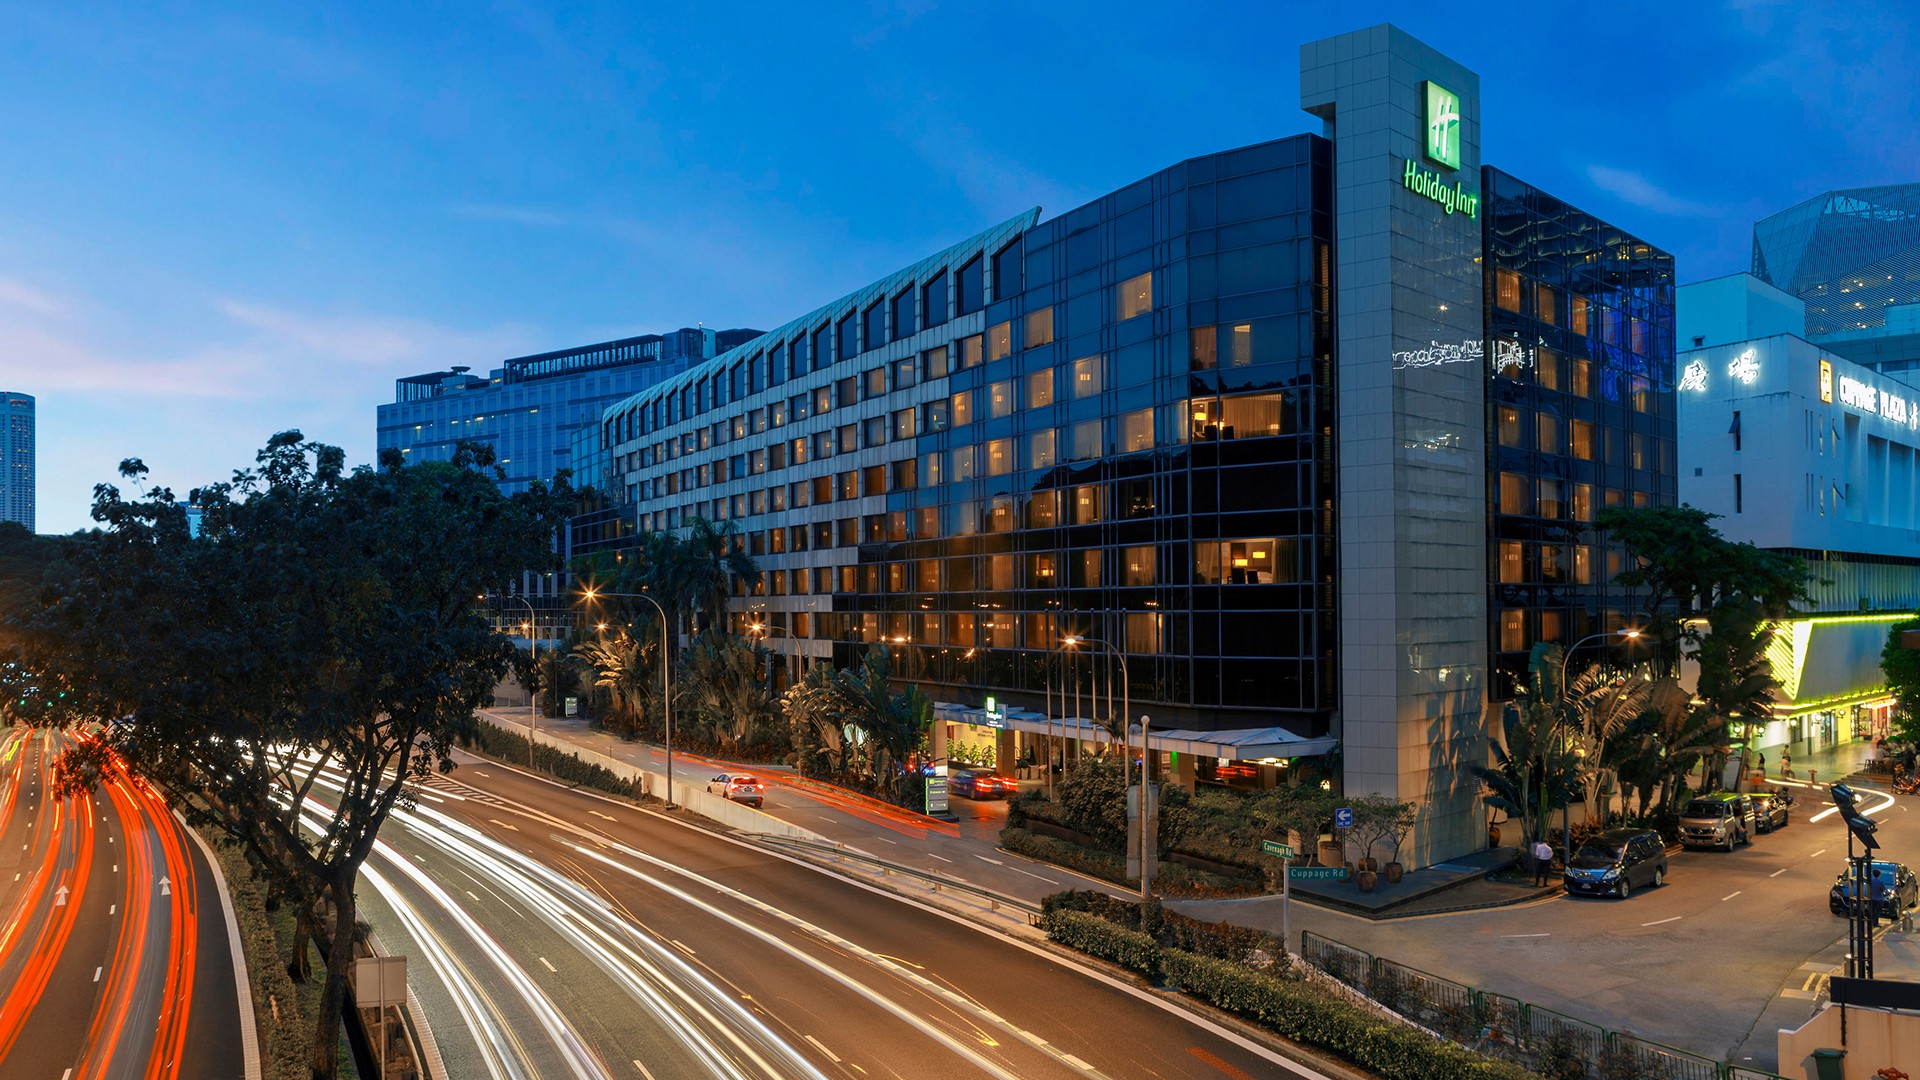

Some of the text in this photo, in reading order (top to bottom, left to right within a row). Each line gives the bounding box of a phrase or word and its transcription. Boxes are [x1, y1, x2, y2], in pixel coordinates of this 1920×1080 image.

[1404, 158, 1477, 218] Holiday Inn
[1879, 390, 1907, 424] PLAZA
[1263, 842, 1292, 857] Cavenagh Rd
[1291, 868, 1344, 878] Cuppage Rd
